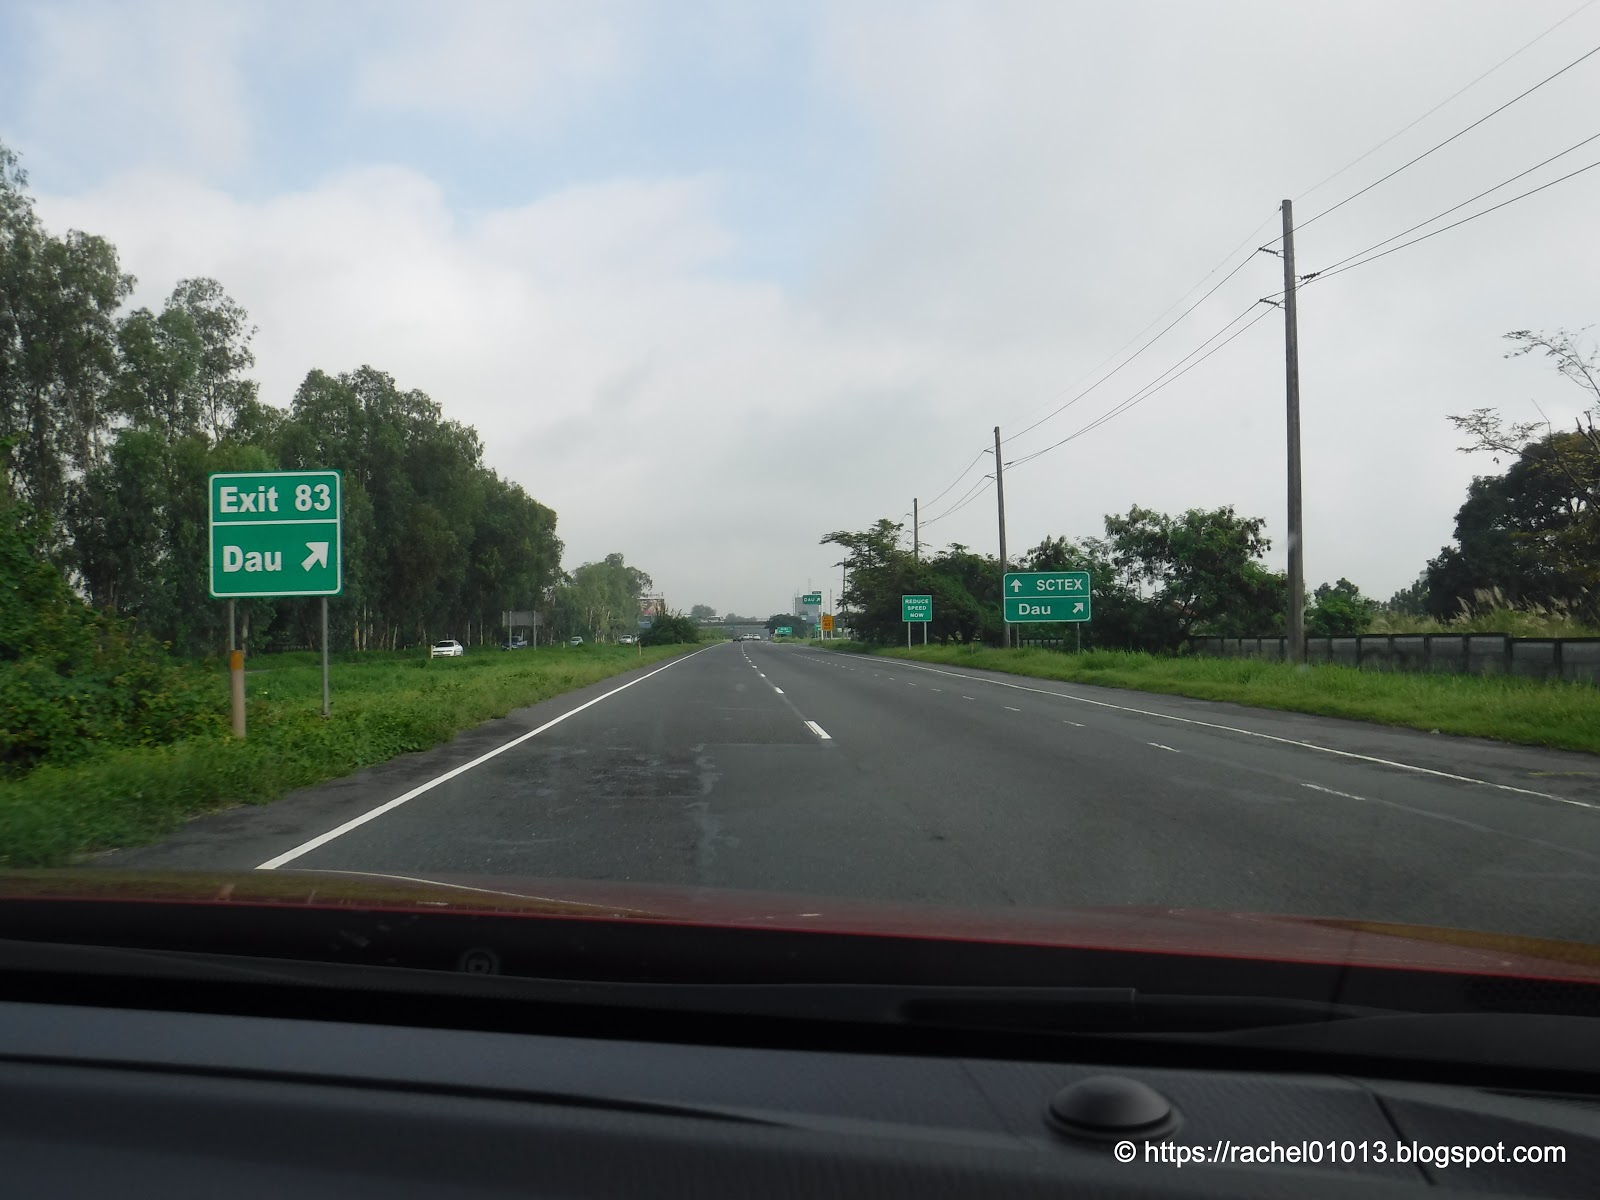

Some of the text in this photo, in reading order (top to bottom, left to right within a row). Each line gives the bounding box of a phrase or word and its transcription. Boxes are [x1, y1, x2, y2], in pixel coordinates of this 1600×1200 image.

[219, 483, 331, 513] Exit 83
[222, 545, 282, 573] Dau
[1036, 578, 1083, 591] SCTEX
[1018, 603, 1051, 615] Dau
